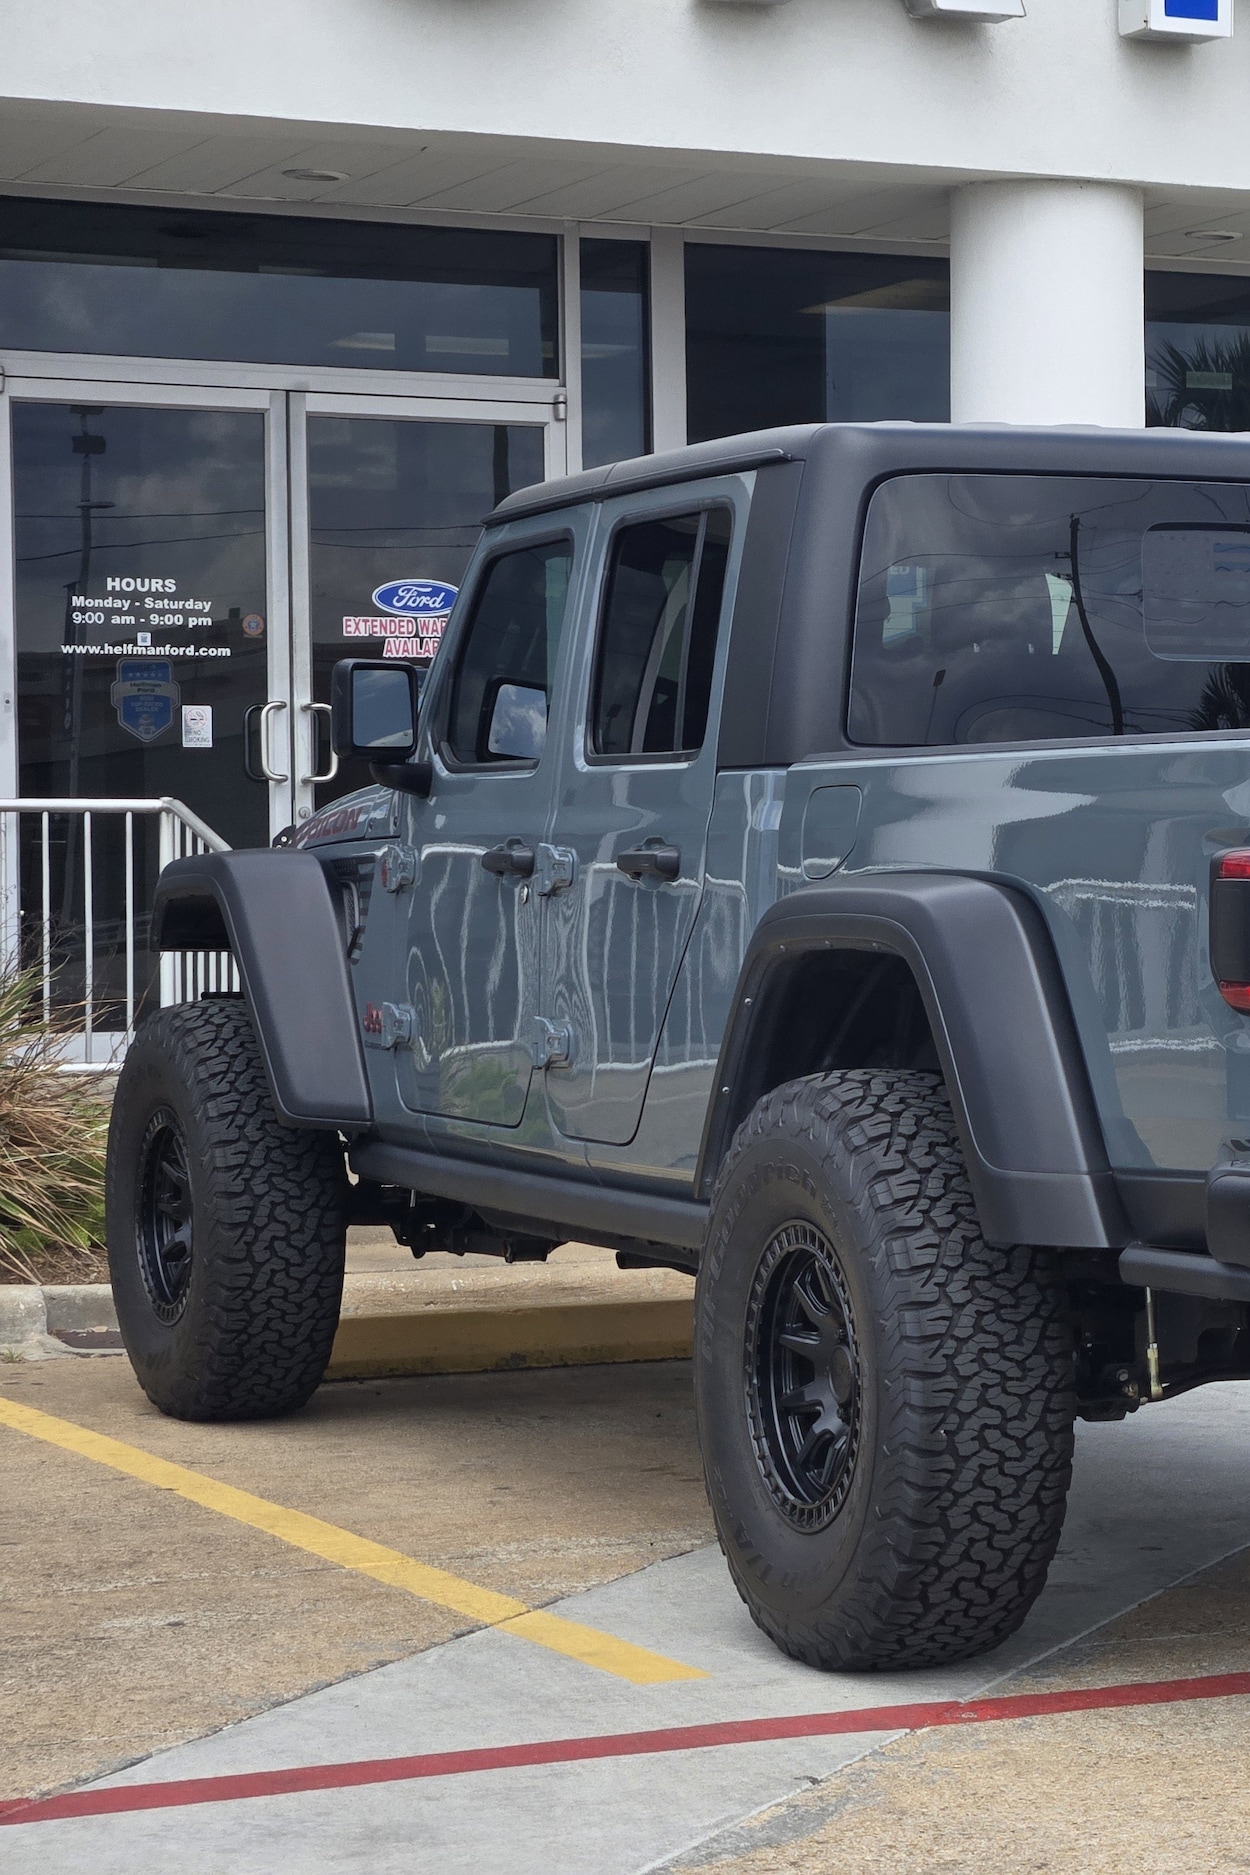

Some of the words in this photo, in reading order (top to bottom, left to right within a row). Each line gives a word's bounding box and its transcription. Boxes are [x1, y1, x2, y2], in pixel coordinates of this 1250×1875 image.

[106, 577, 177, 593] HOURS
[72, 596, 131, 611] Monday
[144, 597, 212, 613] Saturday
[392, 585, 446, 608] Ford
[72, 612, 105, 625] 9:00
[111, 616, 136, 625] am
[149, 613, 184, 626] 9:00
[188, 617, 213, 629] pm
[343, 617, 416, 636] EXTENDED
[61, 643, 232, 657] www.helfmanford.com
